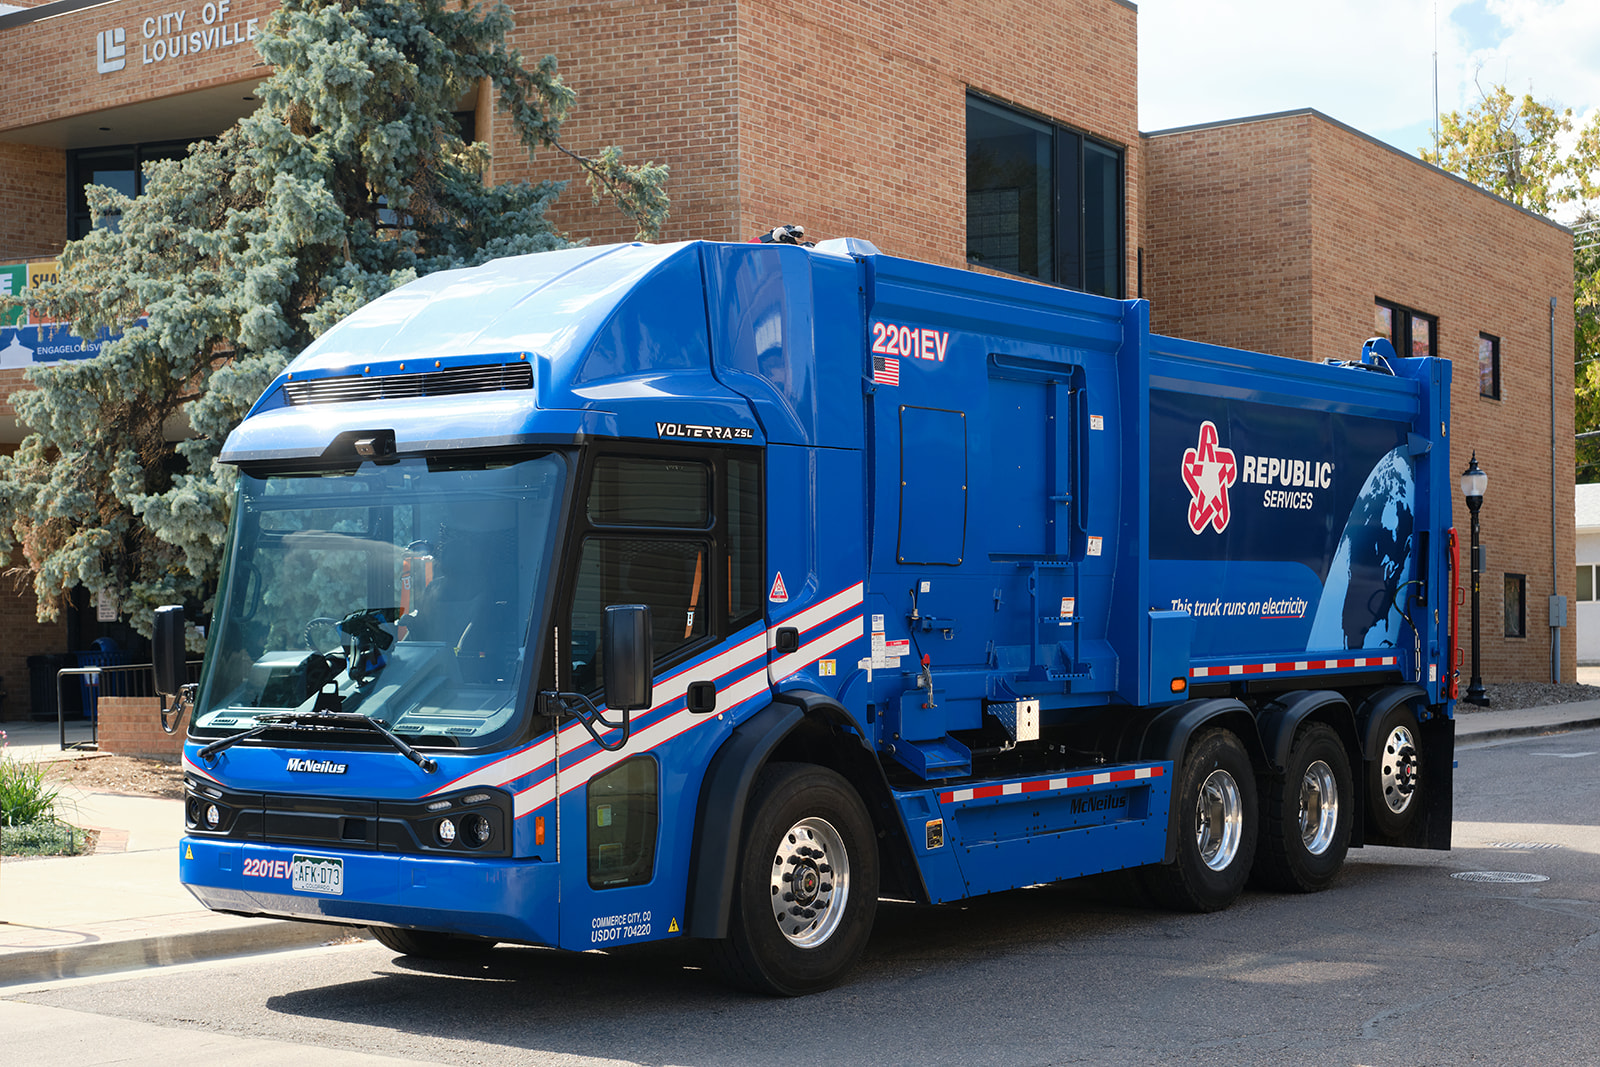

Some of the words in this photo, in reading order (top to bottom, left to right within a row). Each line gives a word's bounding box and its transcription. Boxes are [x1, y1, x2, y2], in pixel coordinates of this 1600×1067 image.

[143, 10, 186, 39] CITY
[202, 0, 231, 25] OF
[143, 18, 259, 65] LOUISVILLE
[32, 273, 62, 290] SHA
[872, 321, 949, 362] 2201EV
[656, 422, 733, 440] VOLTERRA
[734, 428, 753, 438] ZSL
[1242, 455, 1332, 489] REPUBLIC
[1263, 489, 1314, 510] SERVICES
[1171, 598, 1193, 615] This
[1194, 598, 1222, 617] truck
[1222, 600, 1247, 616] runs
[1247, 601, 1261, 615] on
[1261, 597, 1308, 618] electricity
[286, 757, 347, 774] McNeilus
[1070, 794, 1126, 815] McNeilus
[243, 858, 294, 879] 2201EV
[591, 914, 627, 929] COMMERCE
[627, 912, 642, 924] CITY,
[642, 910, 652, 922] CO
[591, 927, 622, 943] USDOT
[623, 923, 652, 938] 704220
